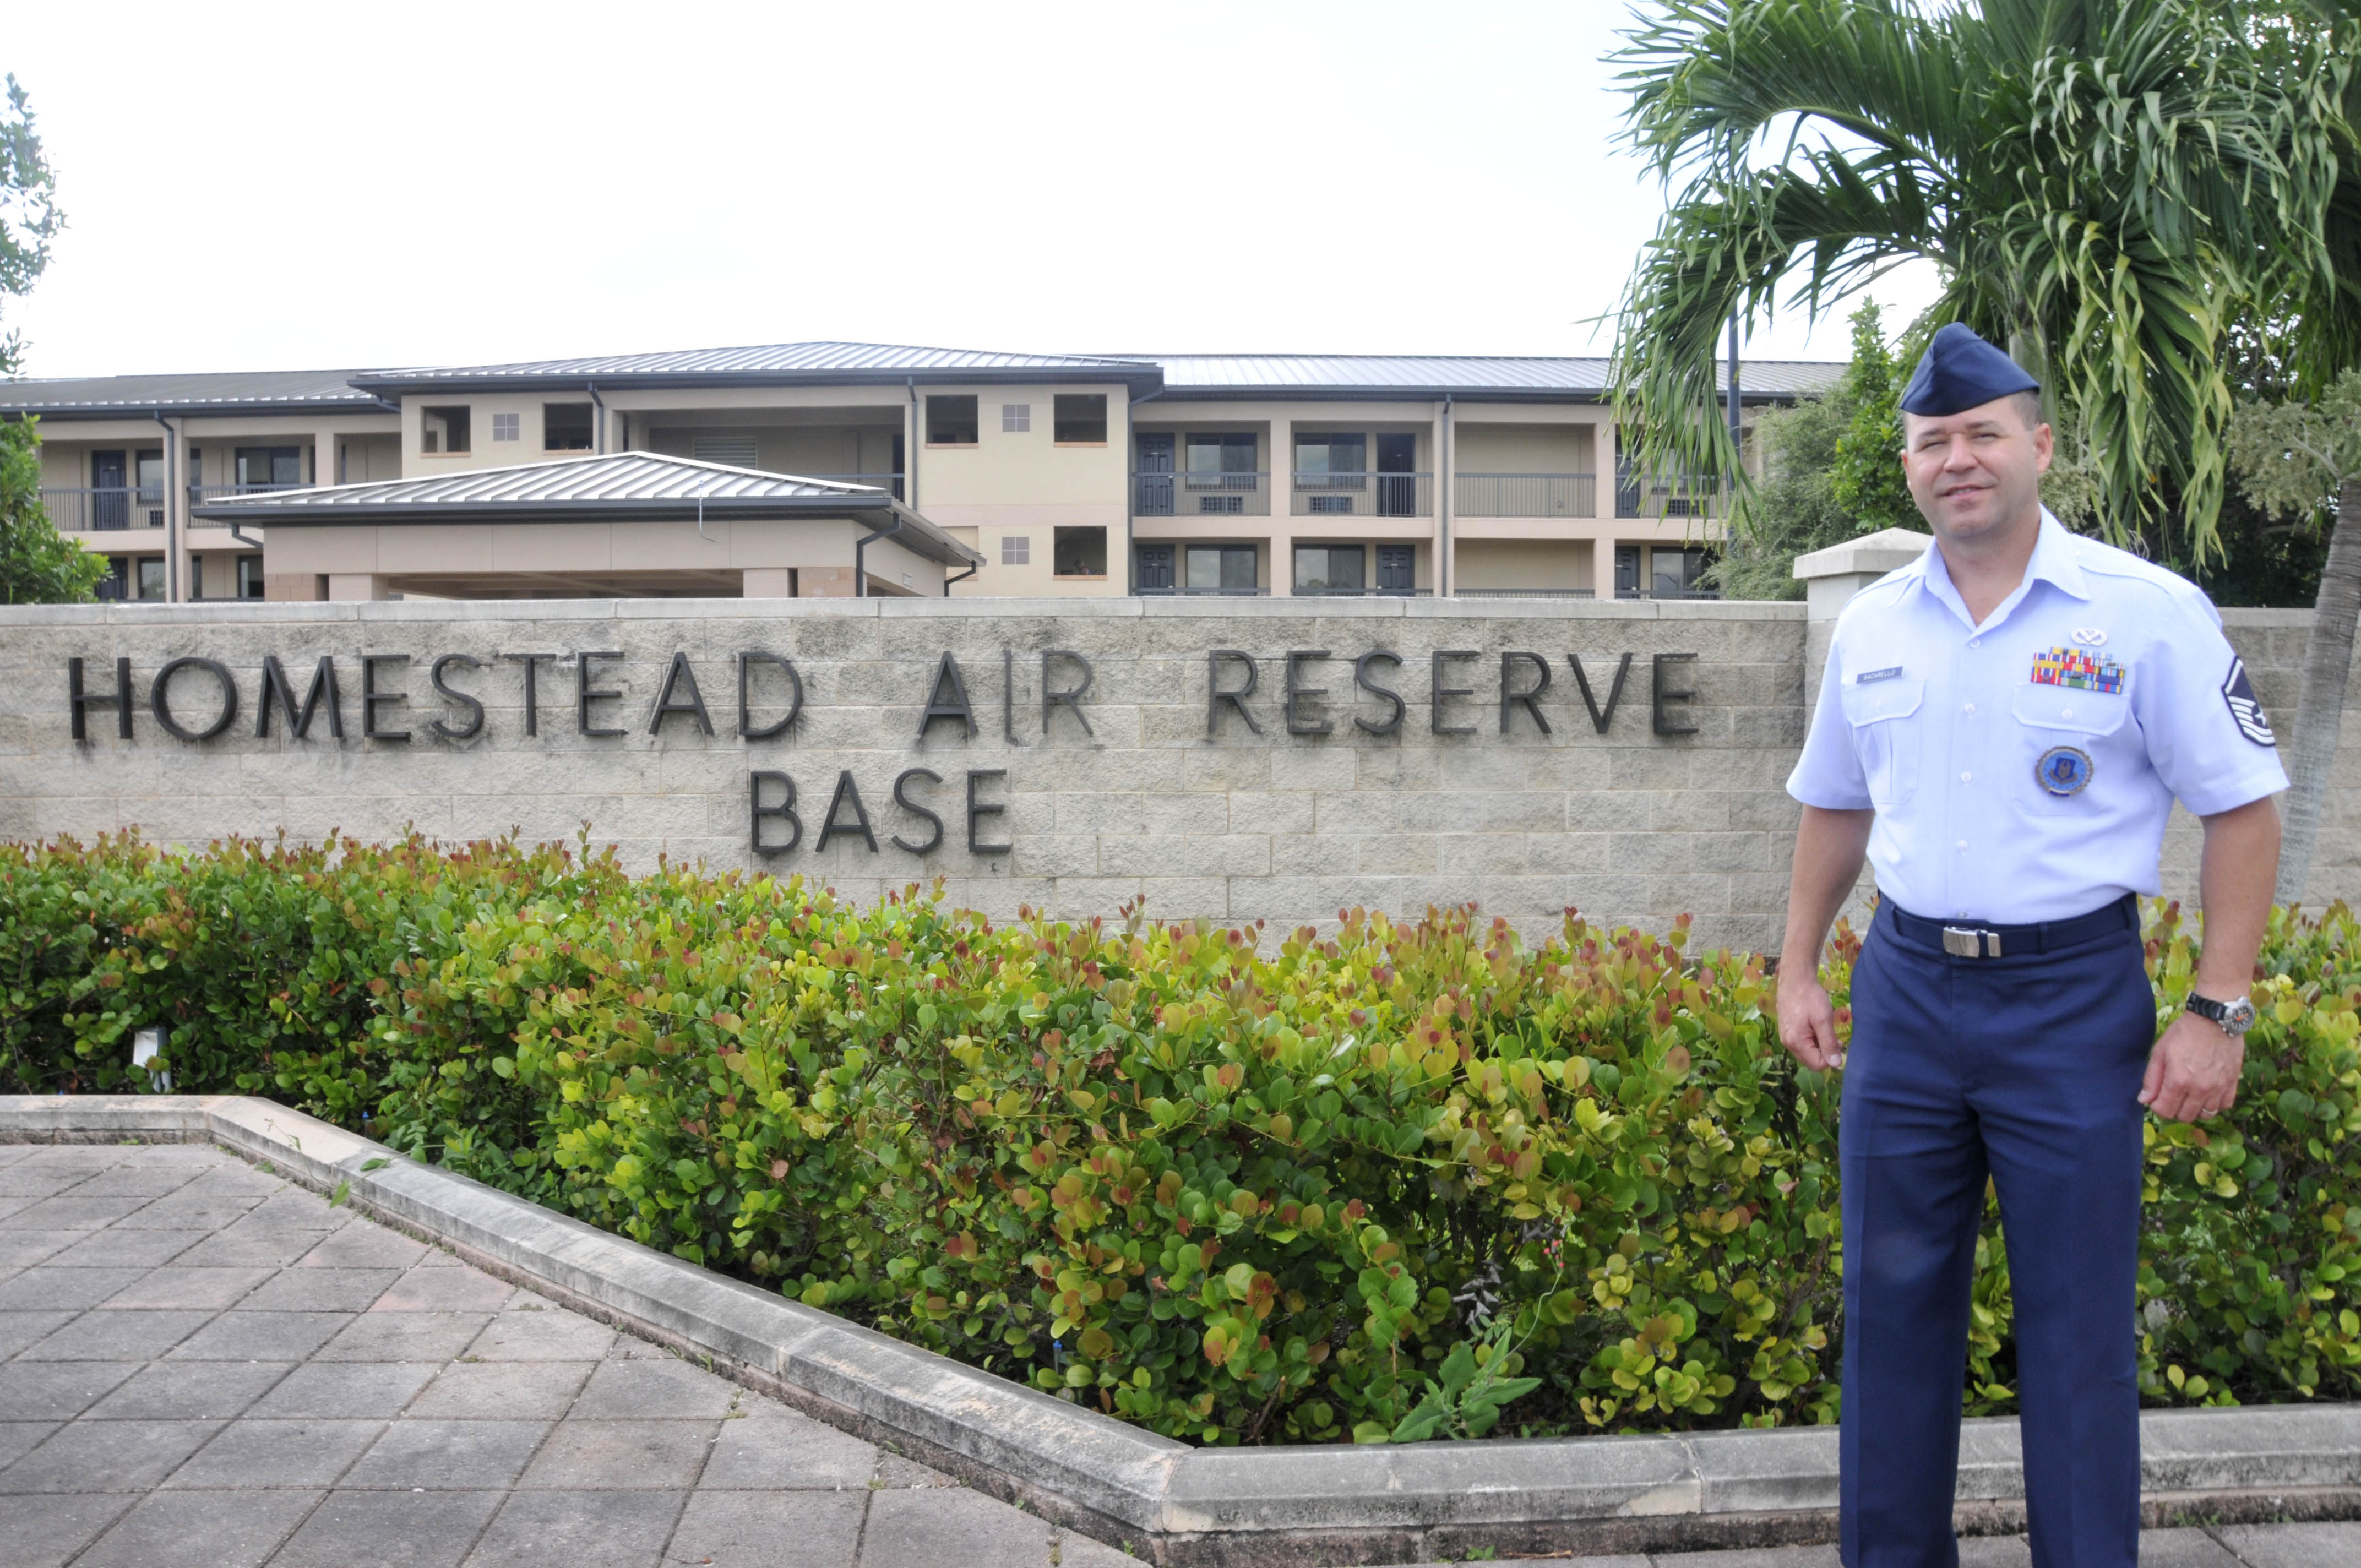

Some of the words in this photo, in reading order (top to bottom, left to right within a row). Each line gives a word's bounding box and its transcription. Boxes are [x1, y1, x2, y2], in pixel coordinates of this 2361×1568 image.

[68, 651, 803, 741] HOMESTEAD
[917, 650, 1094, 742] AIR
[1208, 650, 1699, 734] RESERVE
[750, 769, 1012, 853] BASE
